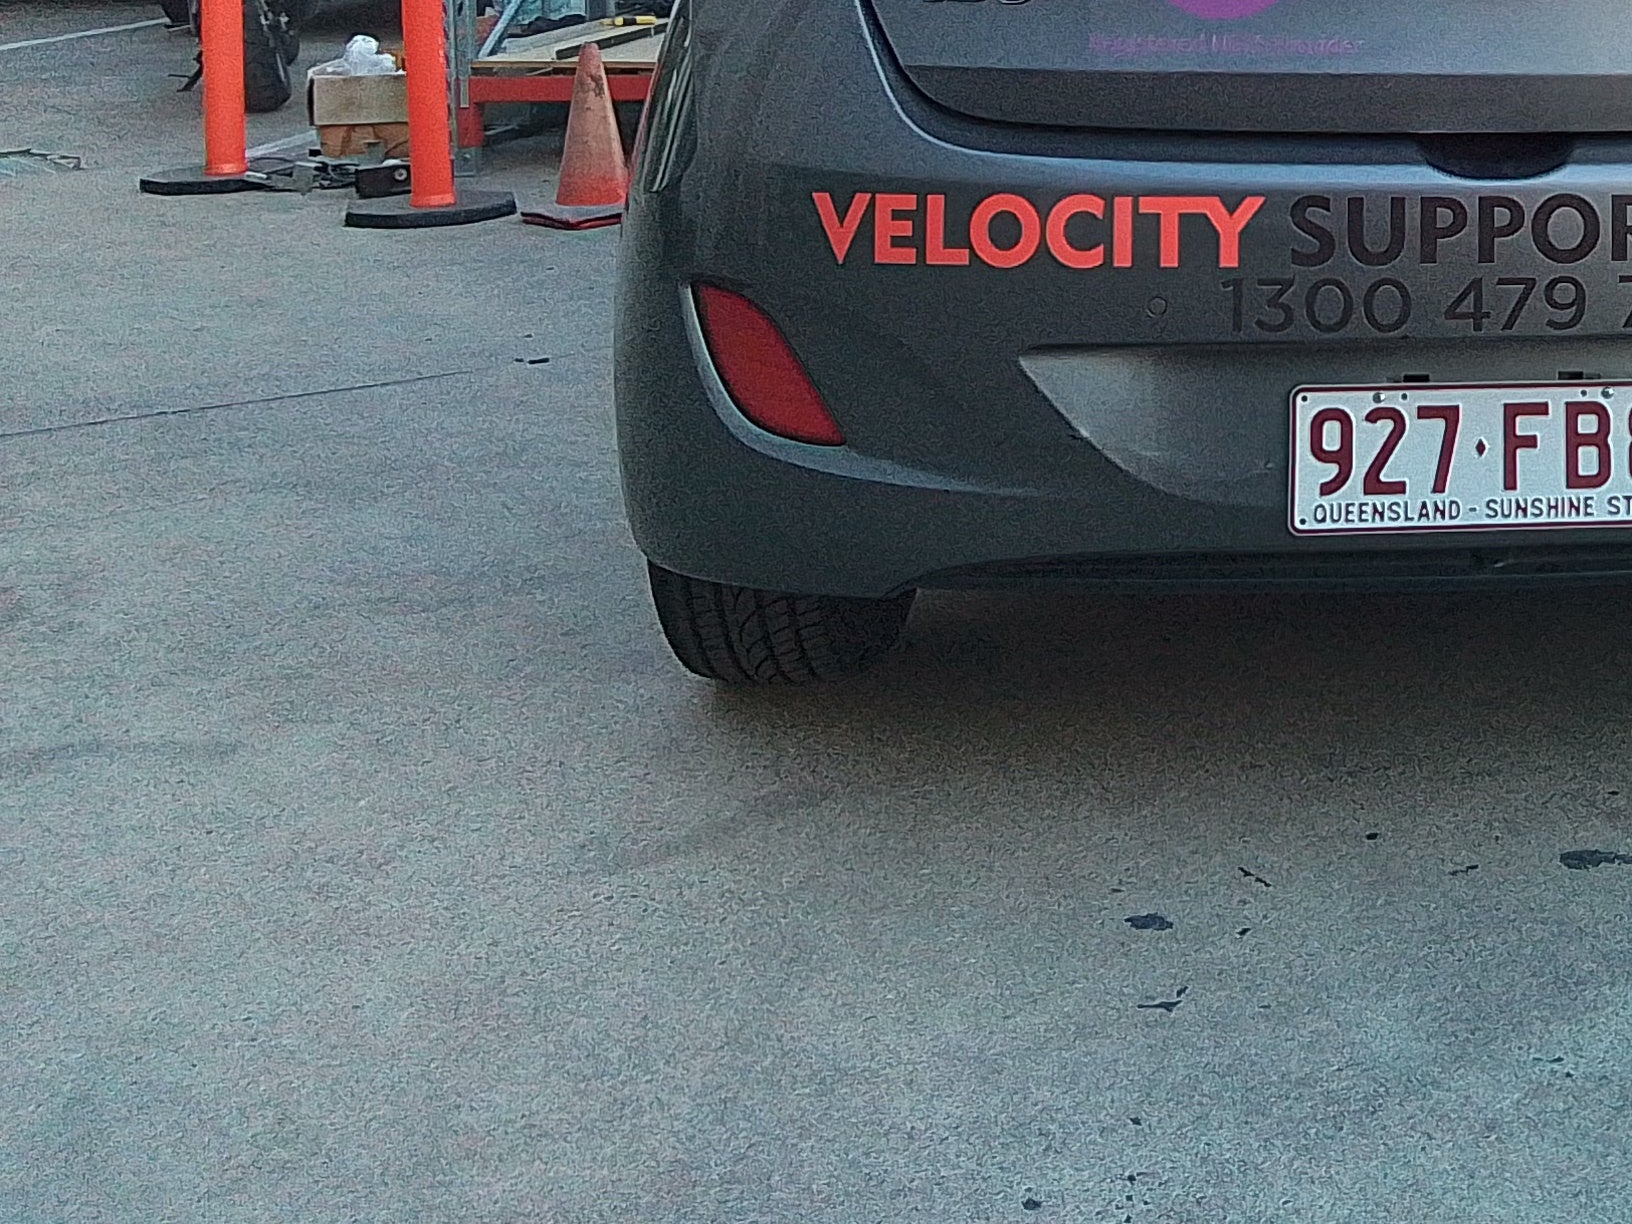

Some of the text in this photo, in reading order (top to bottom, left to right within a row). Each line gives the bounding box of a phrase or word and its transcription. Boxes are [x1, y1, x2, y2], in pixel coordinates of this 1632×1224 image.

[811, 192, 1267, 269] VELOCITY
[1221, 276, 1413, 335] 1300
[1443, 275, 1586, 333] 479
[1309, 403, 1461, 497] 927
[1313, 499, 1461, 524] QUEENSLAND
[1485, 496, 1596, 519] SUNSHINE
